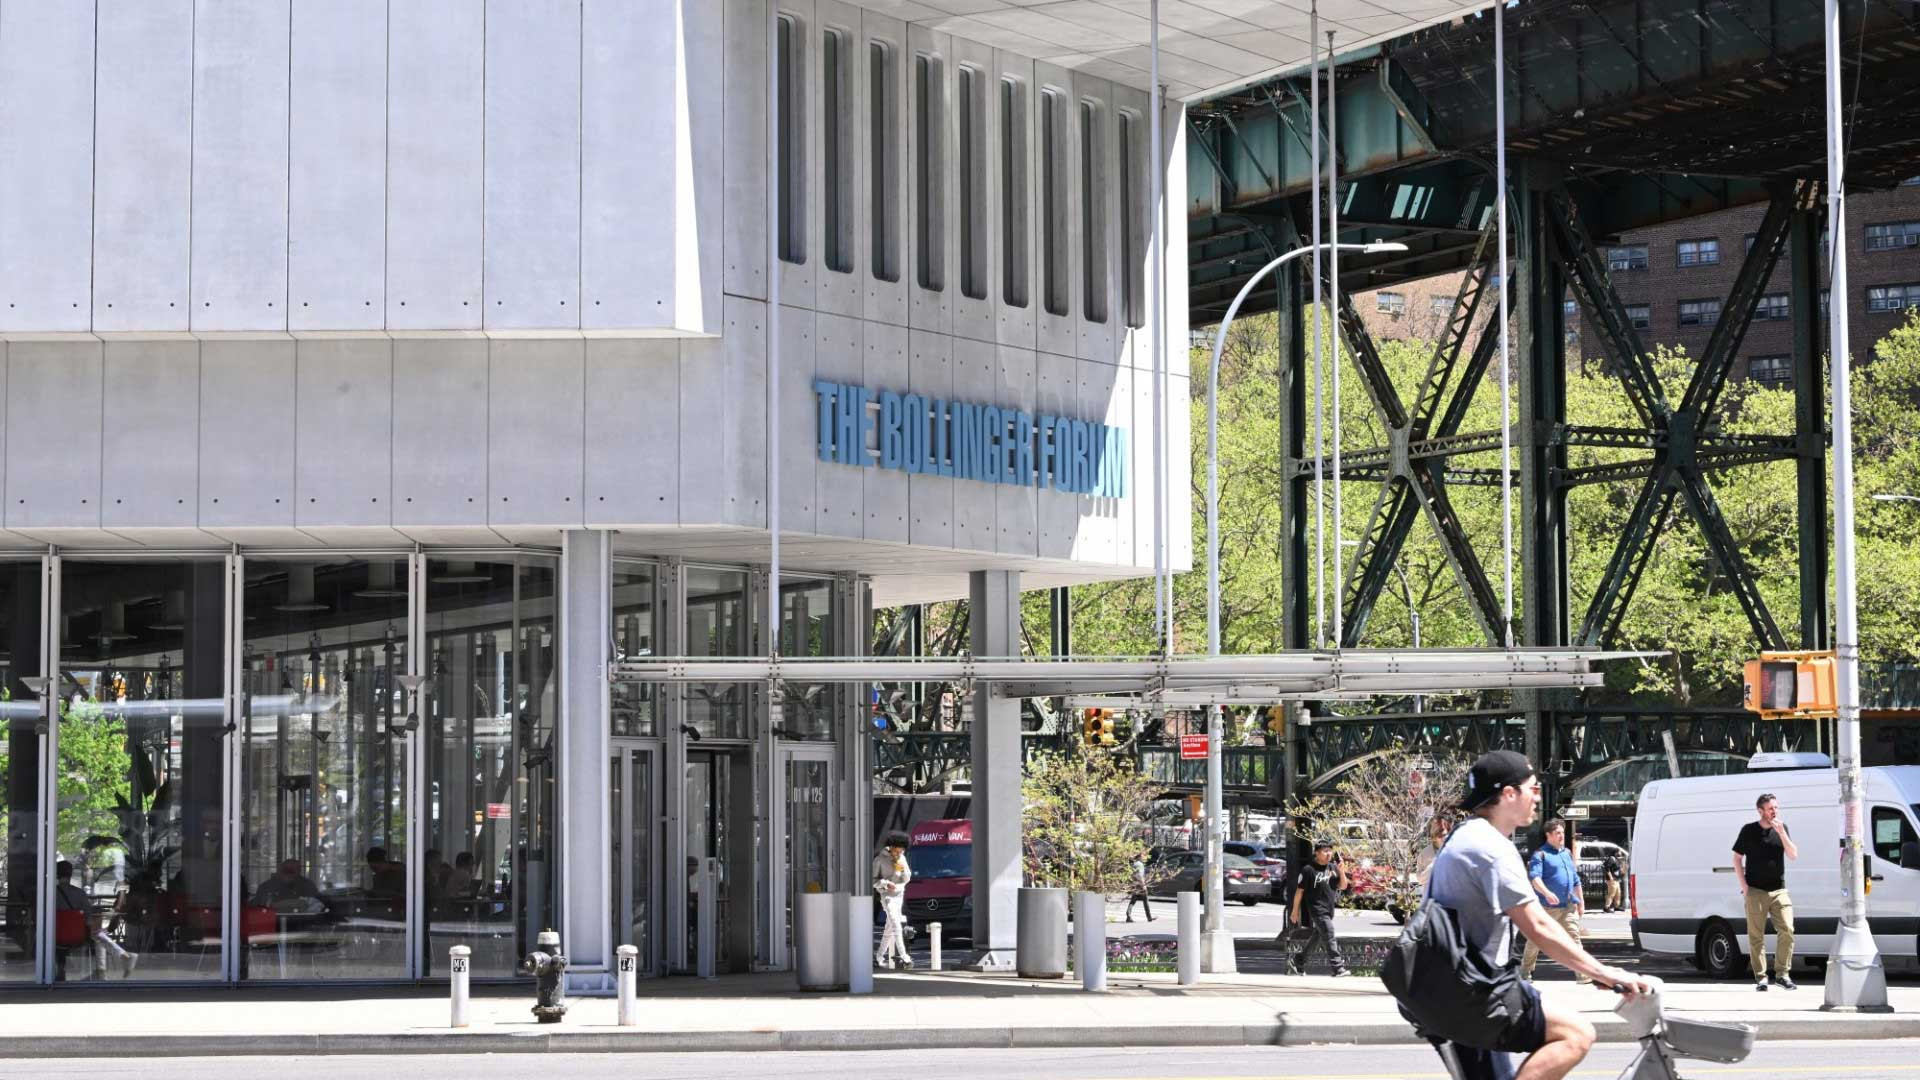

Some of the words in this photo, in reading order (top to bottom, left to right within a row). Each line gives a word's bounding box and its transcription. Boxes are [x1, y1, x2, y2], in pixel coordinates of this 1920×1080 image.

[815, 381, 873, 467] THE
[879, 391, 1033, 488] BOLLINGER
[1036, 414, 1127, 498] FORUM
[811, 786, 823, 803] 125
[921, 832, 937, 842] MAN
[948, 832, 964, 841] VAN
